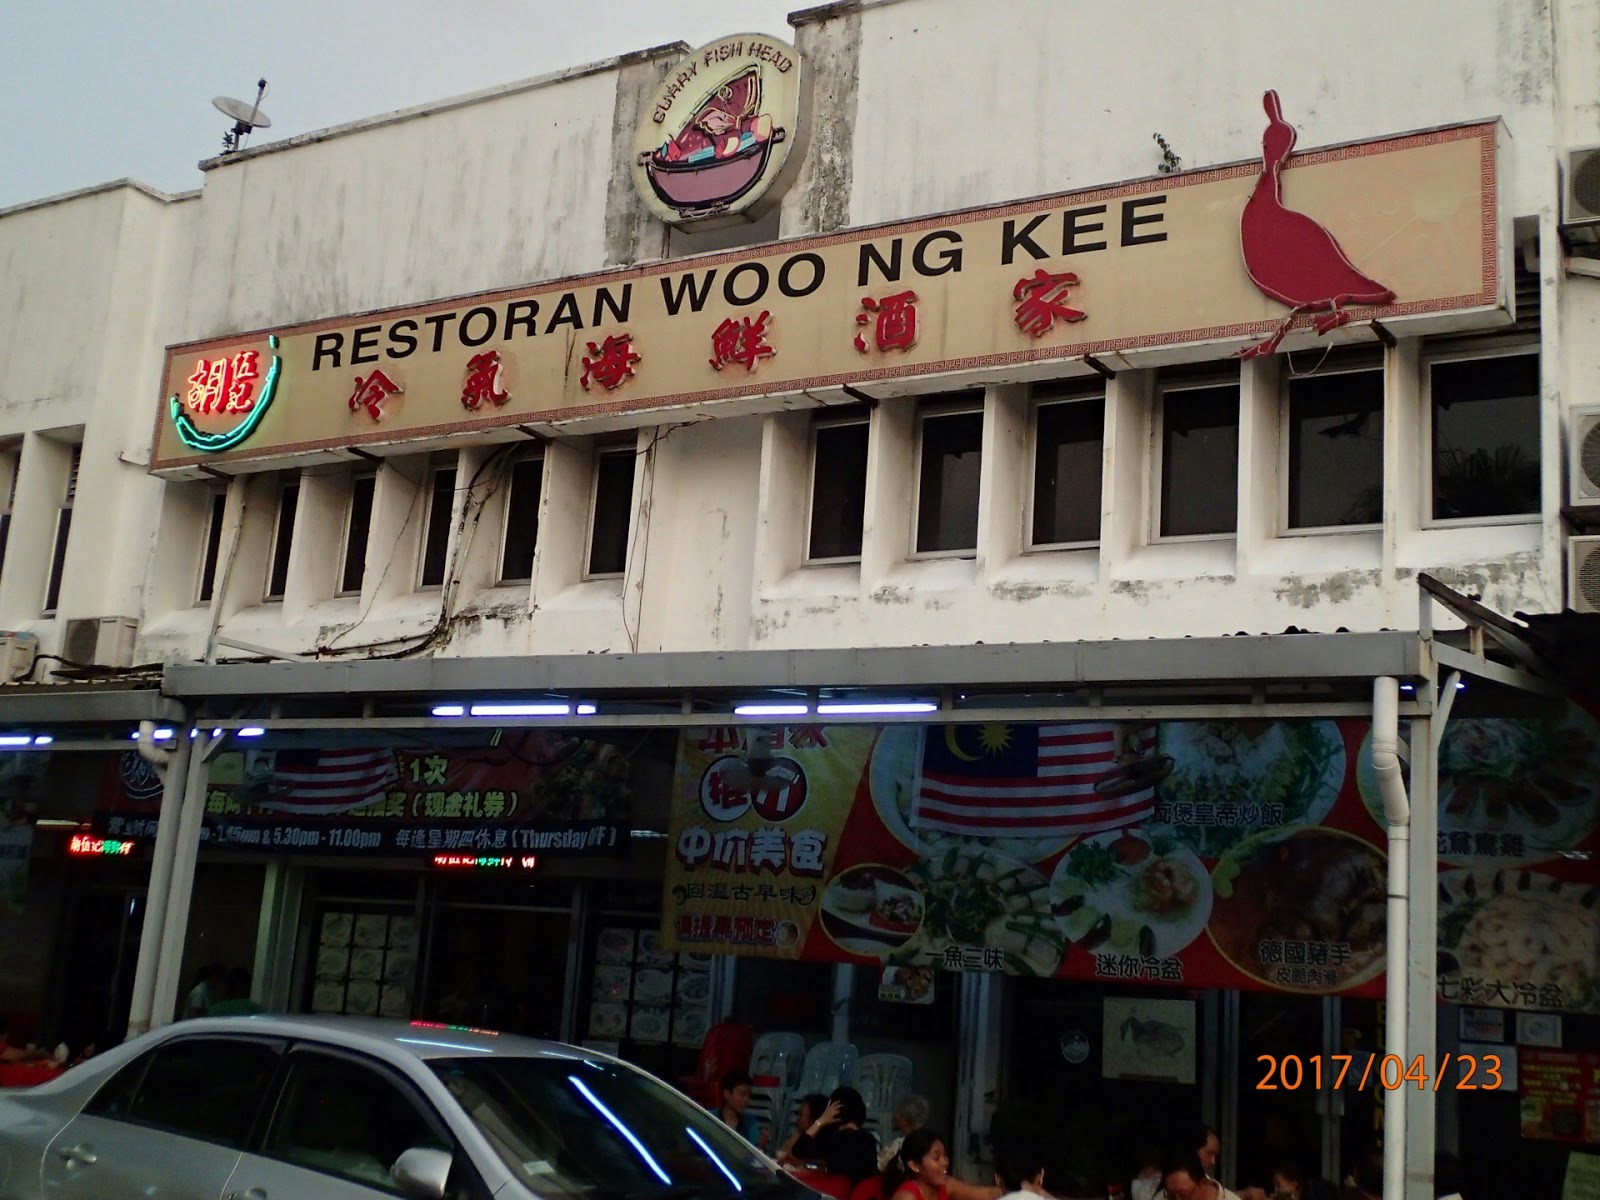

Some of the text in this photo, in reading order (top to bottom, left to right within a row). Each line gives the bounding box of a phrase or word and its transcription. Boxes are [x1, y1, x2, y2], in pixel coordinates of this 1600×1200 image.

[653, 42, 793, 124] CURRY FISH HEAD
[312, 195, 1168, 370] RESTORAN WOO NG KEE
[272, 827, 320, 847] 5.30pm
[328, 829, 382, 849] 11.00pm
[677, 826, 828, 873] 中价美食
[1096, 953, 1183, 981] 迷你冷盆
